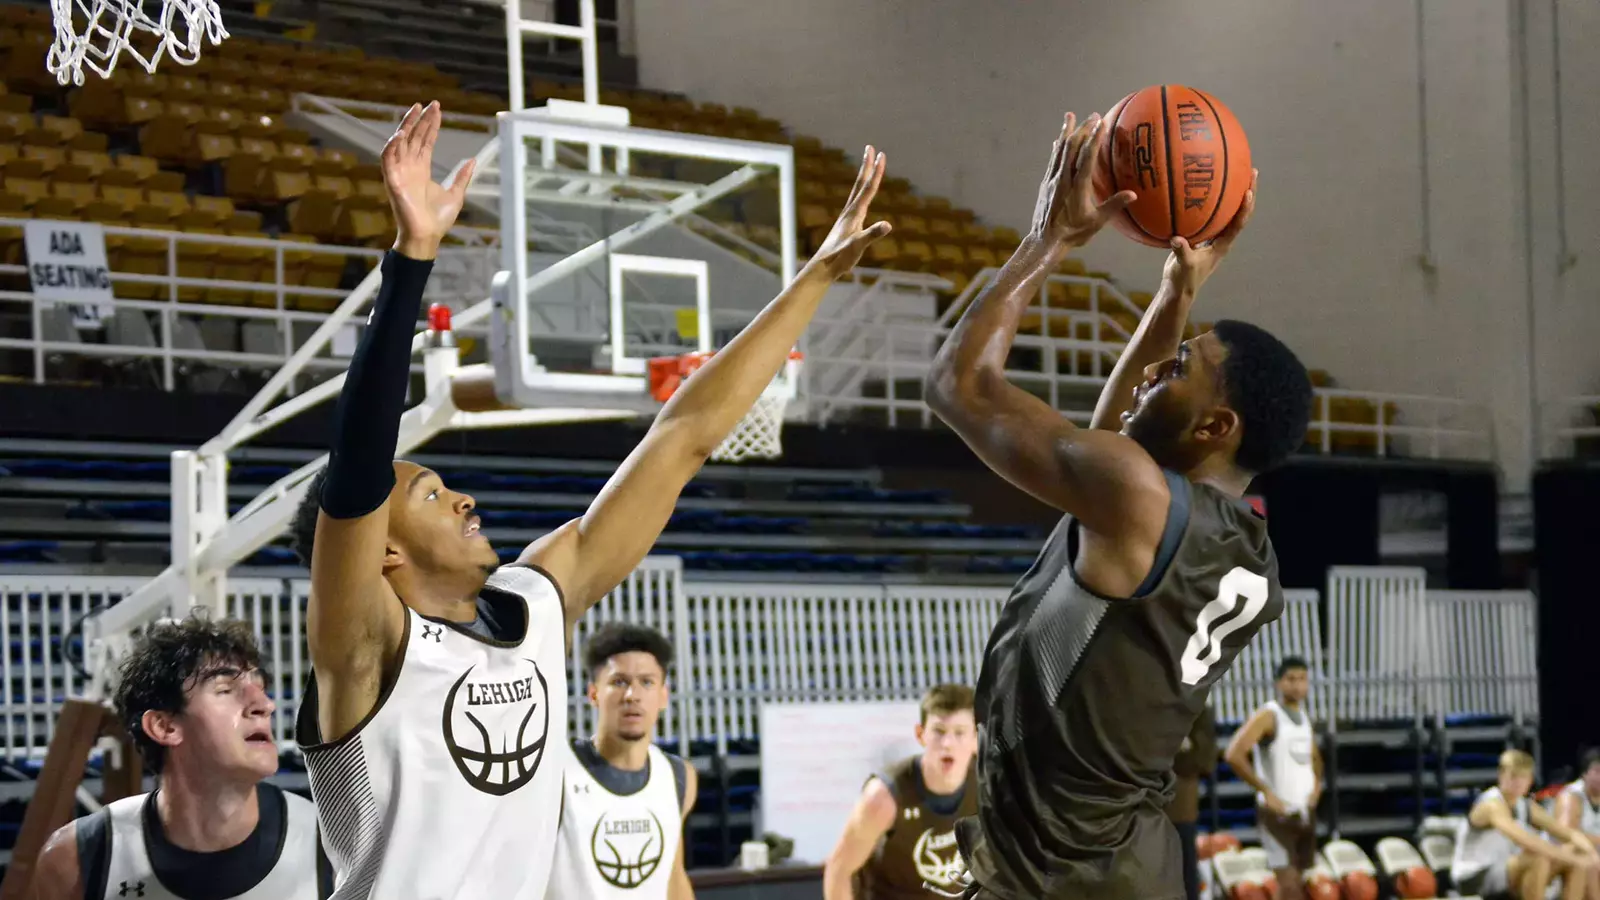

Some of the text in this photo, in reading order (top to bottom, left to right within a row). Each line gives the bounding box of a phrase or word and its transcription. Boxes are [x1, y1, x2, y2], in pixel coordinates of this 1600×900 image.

[1177, 101, 1215, 211] THE ROCK
[49, 231, 85, 255] ADA
[33, 262, 110, 290] SEATING
[1180, 566, 1269, 686] 0
[467, 676, 534, 706] LEHIGH
[604, 819, 651, 835] LEHIGH
